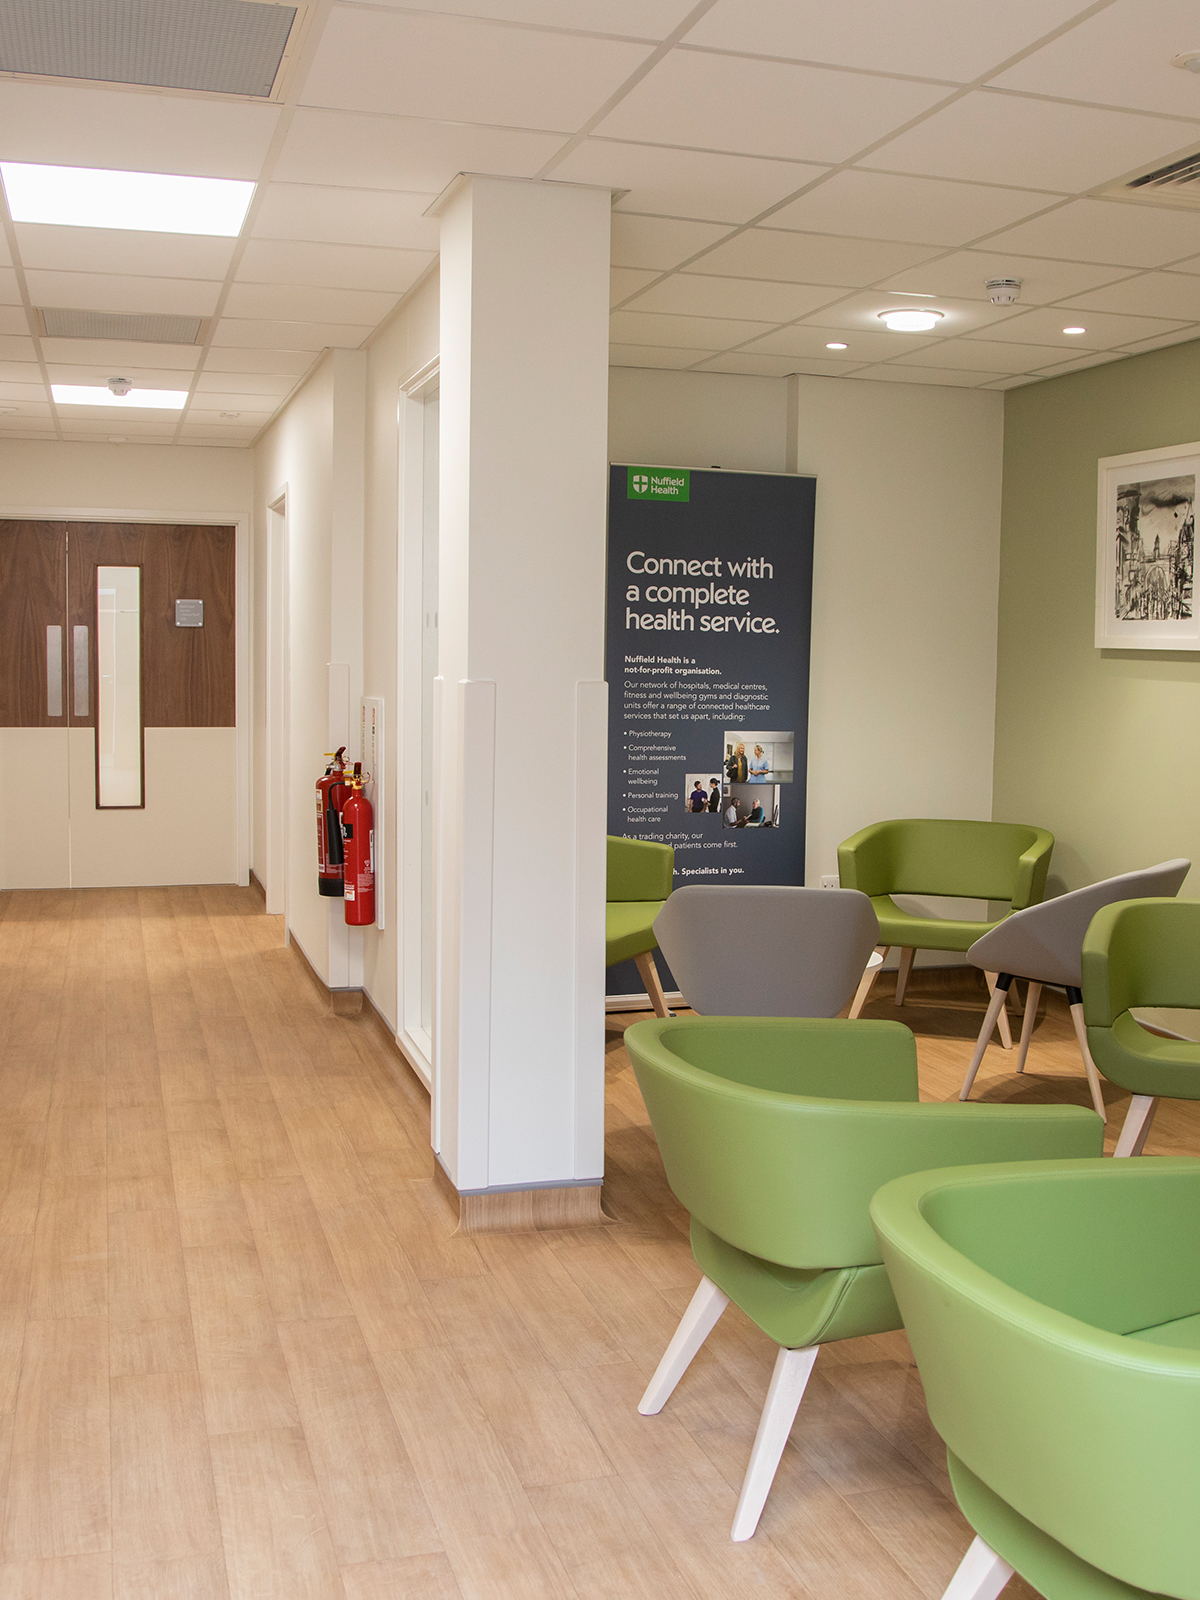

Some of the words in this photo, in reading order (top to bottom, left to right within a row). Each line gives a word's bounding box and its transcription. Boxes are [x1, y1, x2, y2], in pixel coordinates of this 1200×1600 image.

[651, 477, 685, 487] Nuffield
[651, 485, 679, 495] Health
[627, 551, 722, 577] Connect
[727, 557, 773, 579] with
[626, 585, 639, 601] a
[646, 582, 749, 609] complete
[626, 607, 694, 631] health
[700, 612, 779, 633] service.
[624, 654, 656, 664] Nuffield
[656, 656, 682, 664] Health
[682, 656, 690, 664] is
[624, 666, 674, 676] not-for-profit
[674, 666, 722, 676] organisation.
[624, 680, 638, 688] Our
[640, 680, 668, 688] network
[670, 680, 678, 688] of
[678, 682, 712, 692] hospitals,
[712, 682, 740, 690] medical
[740, 684, 768, 692] centres,
[624, 690, 648, 698] fitness
[648, 692, 662, 700] and
[662, 692, 698, 702] wellbeing
[698, 694, 718, 702] gyms
[732, 692, 768, 702] diagnostic
[624, 702, 642, 710] units
[642, 700, 660, 710] offer
[666, 704, 688, 712] range
[688, 702, 696, 710] of
[696, 702, 734, 710] connected
[734, 702, 770, 710] healthcare
[624, 712, 652, 720] services
[652, 712, 668, 720] that
[690, 714, 710, 722] apart,
[712, 712, 746, 722] including:
[628, 730, 672, 738] Physiotherapy
[628, 744, 676, 752] Comprehensive
[628, 768, 660, 776] Emotional
[628, 778, 658, 786] wellbeing
[654, 792, 678, 800] training
[626, 806, 668, 814] Occupational
[622, 832, 632, 840] As
[638, 832, 664, 842] trading
[664, 832, 690, 842] charity,
[674, 842, 702, 852] patients
[724, 840, 738, 848] first.
[682, 866, 720, 876] Specialists
[728, 868, 744, 876] you.
